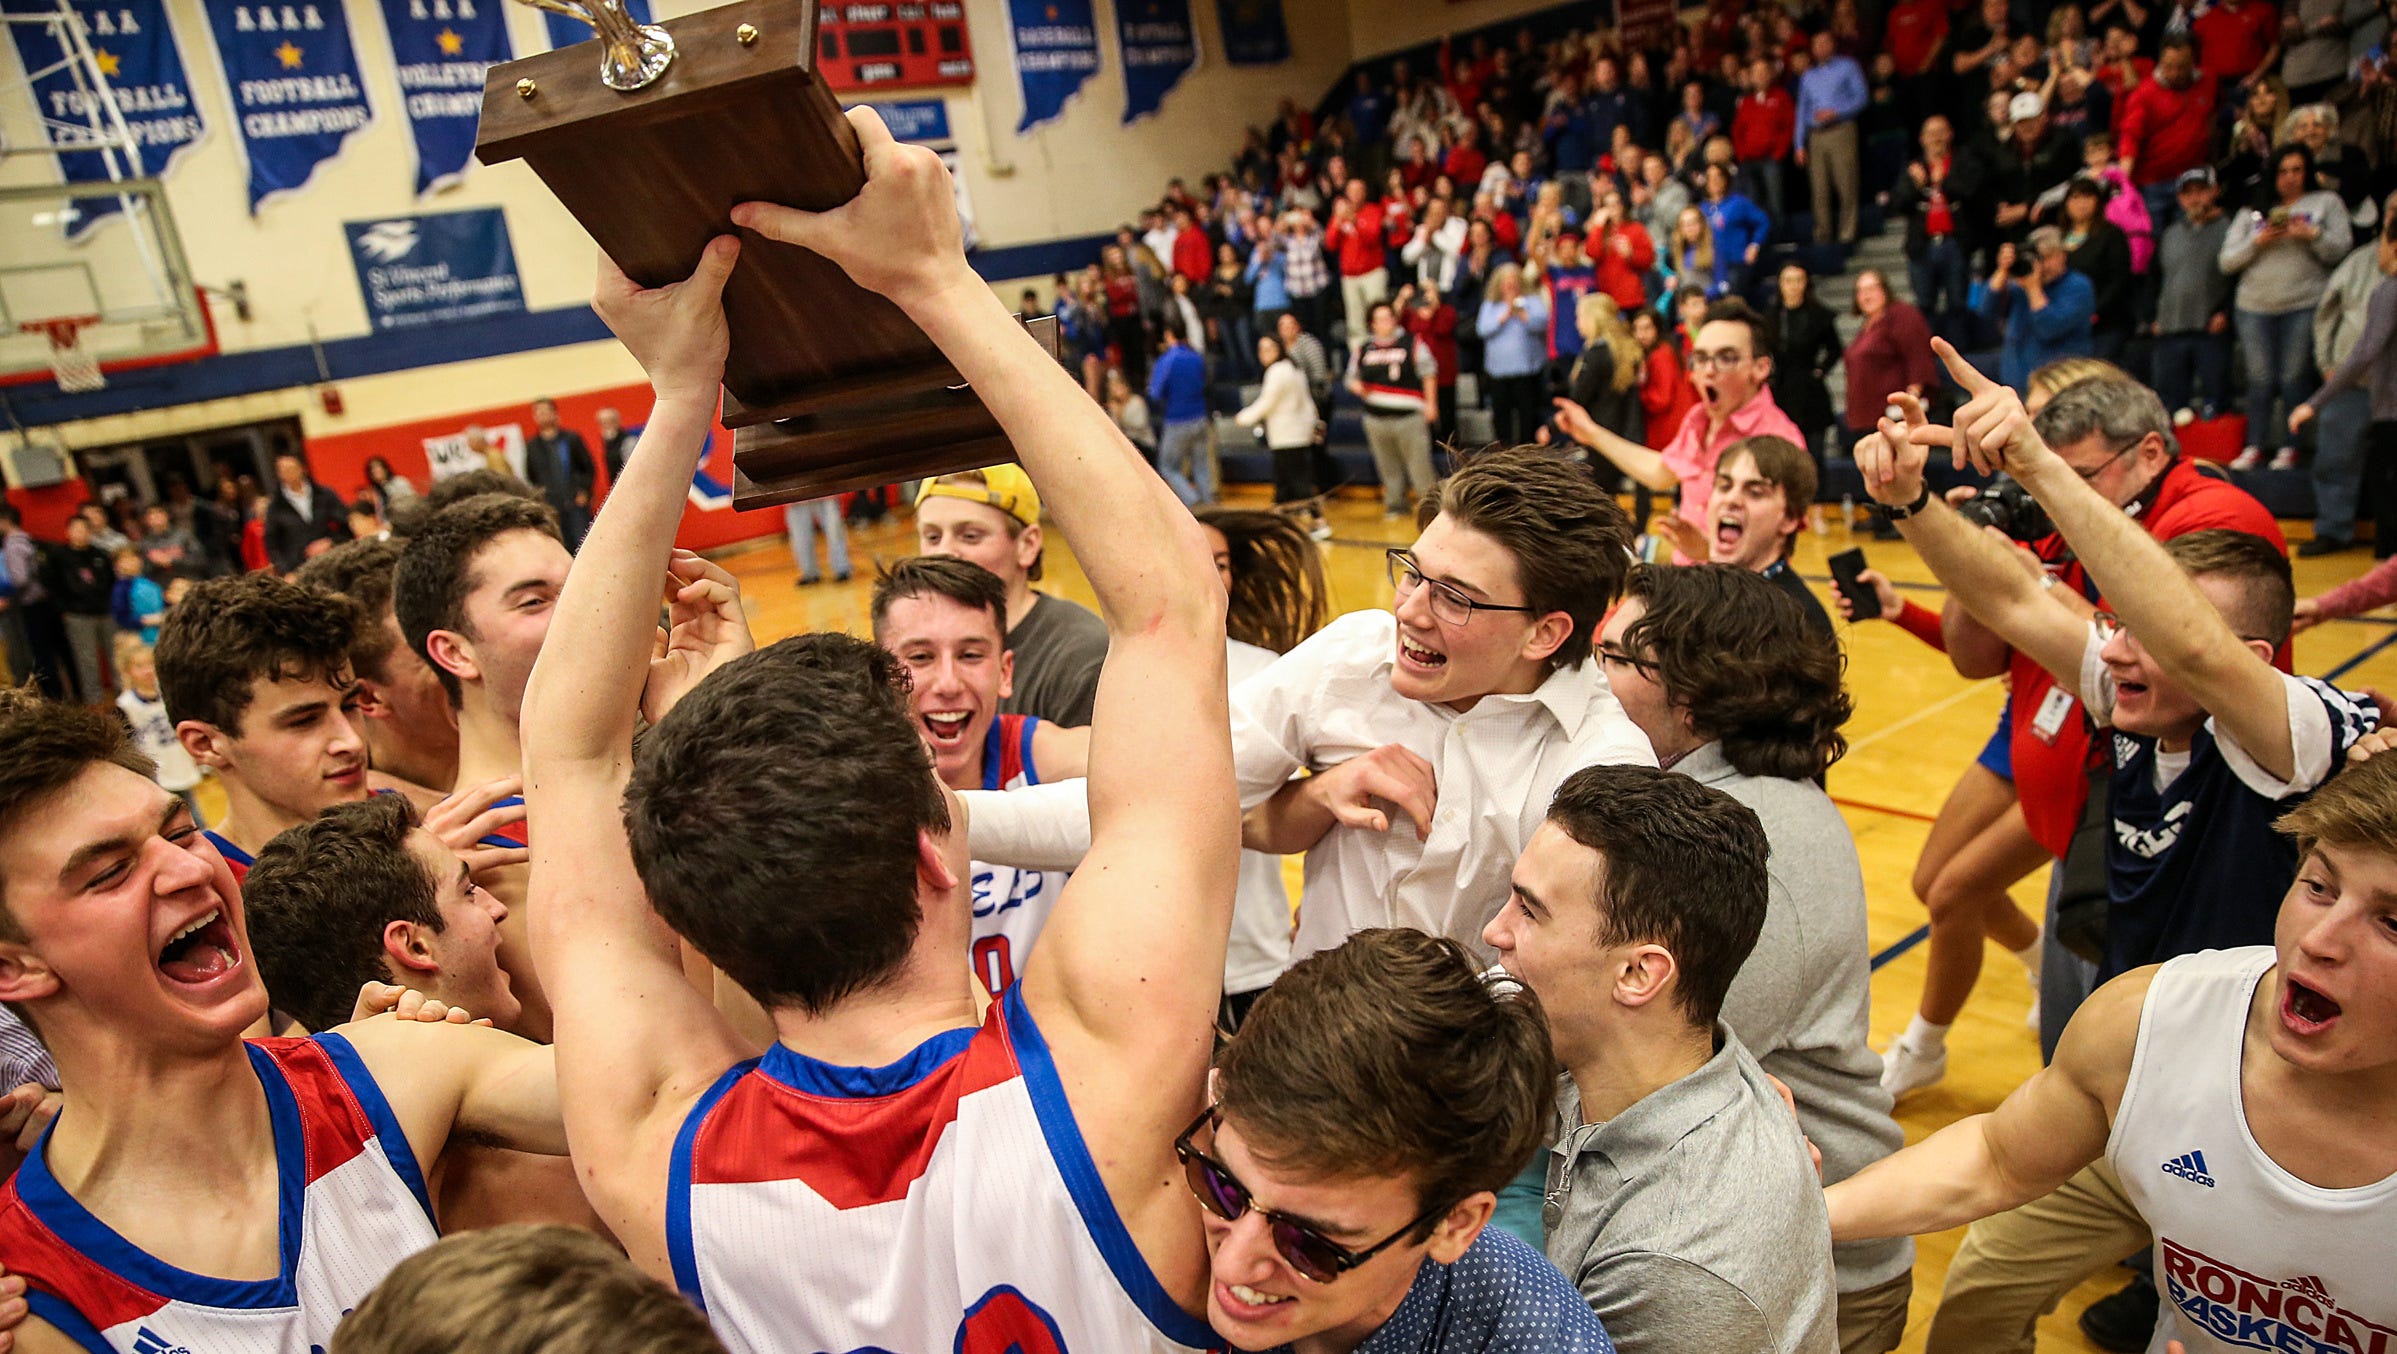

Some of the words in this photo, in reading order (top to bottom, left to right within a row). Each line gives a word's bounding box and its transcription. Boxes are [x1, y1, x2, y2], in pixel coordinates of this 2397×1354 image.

[50, 83, 187, 116] FOBALL
[239, 73, 360, 106] FOOTBALL
[407, 92, 484, 120] CHAMP
[244, 104, 369, 139] CHAMPIONS
[372, 285, 424, 312] Sports
[423, 273, 518, 302] Performance
[2161, 1160, 2216, 1189] adidas
[2280, 1281, 2336, 1310] adidas
[2165, 1273, 2352, 1354] BASKE
